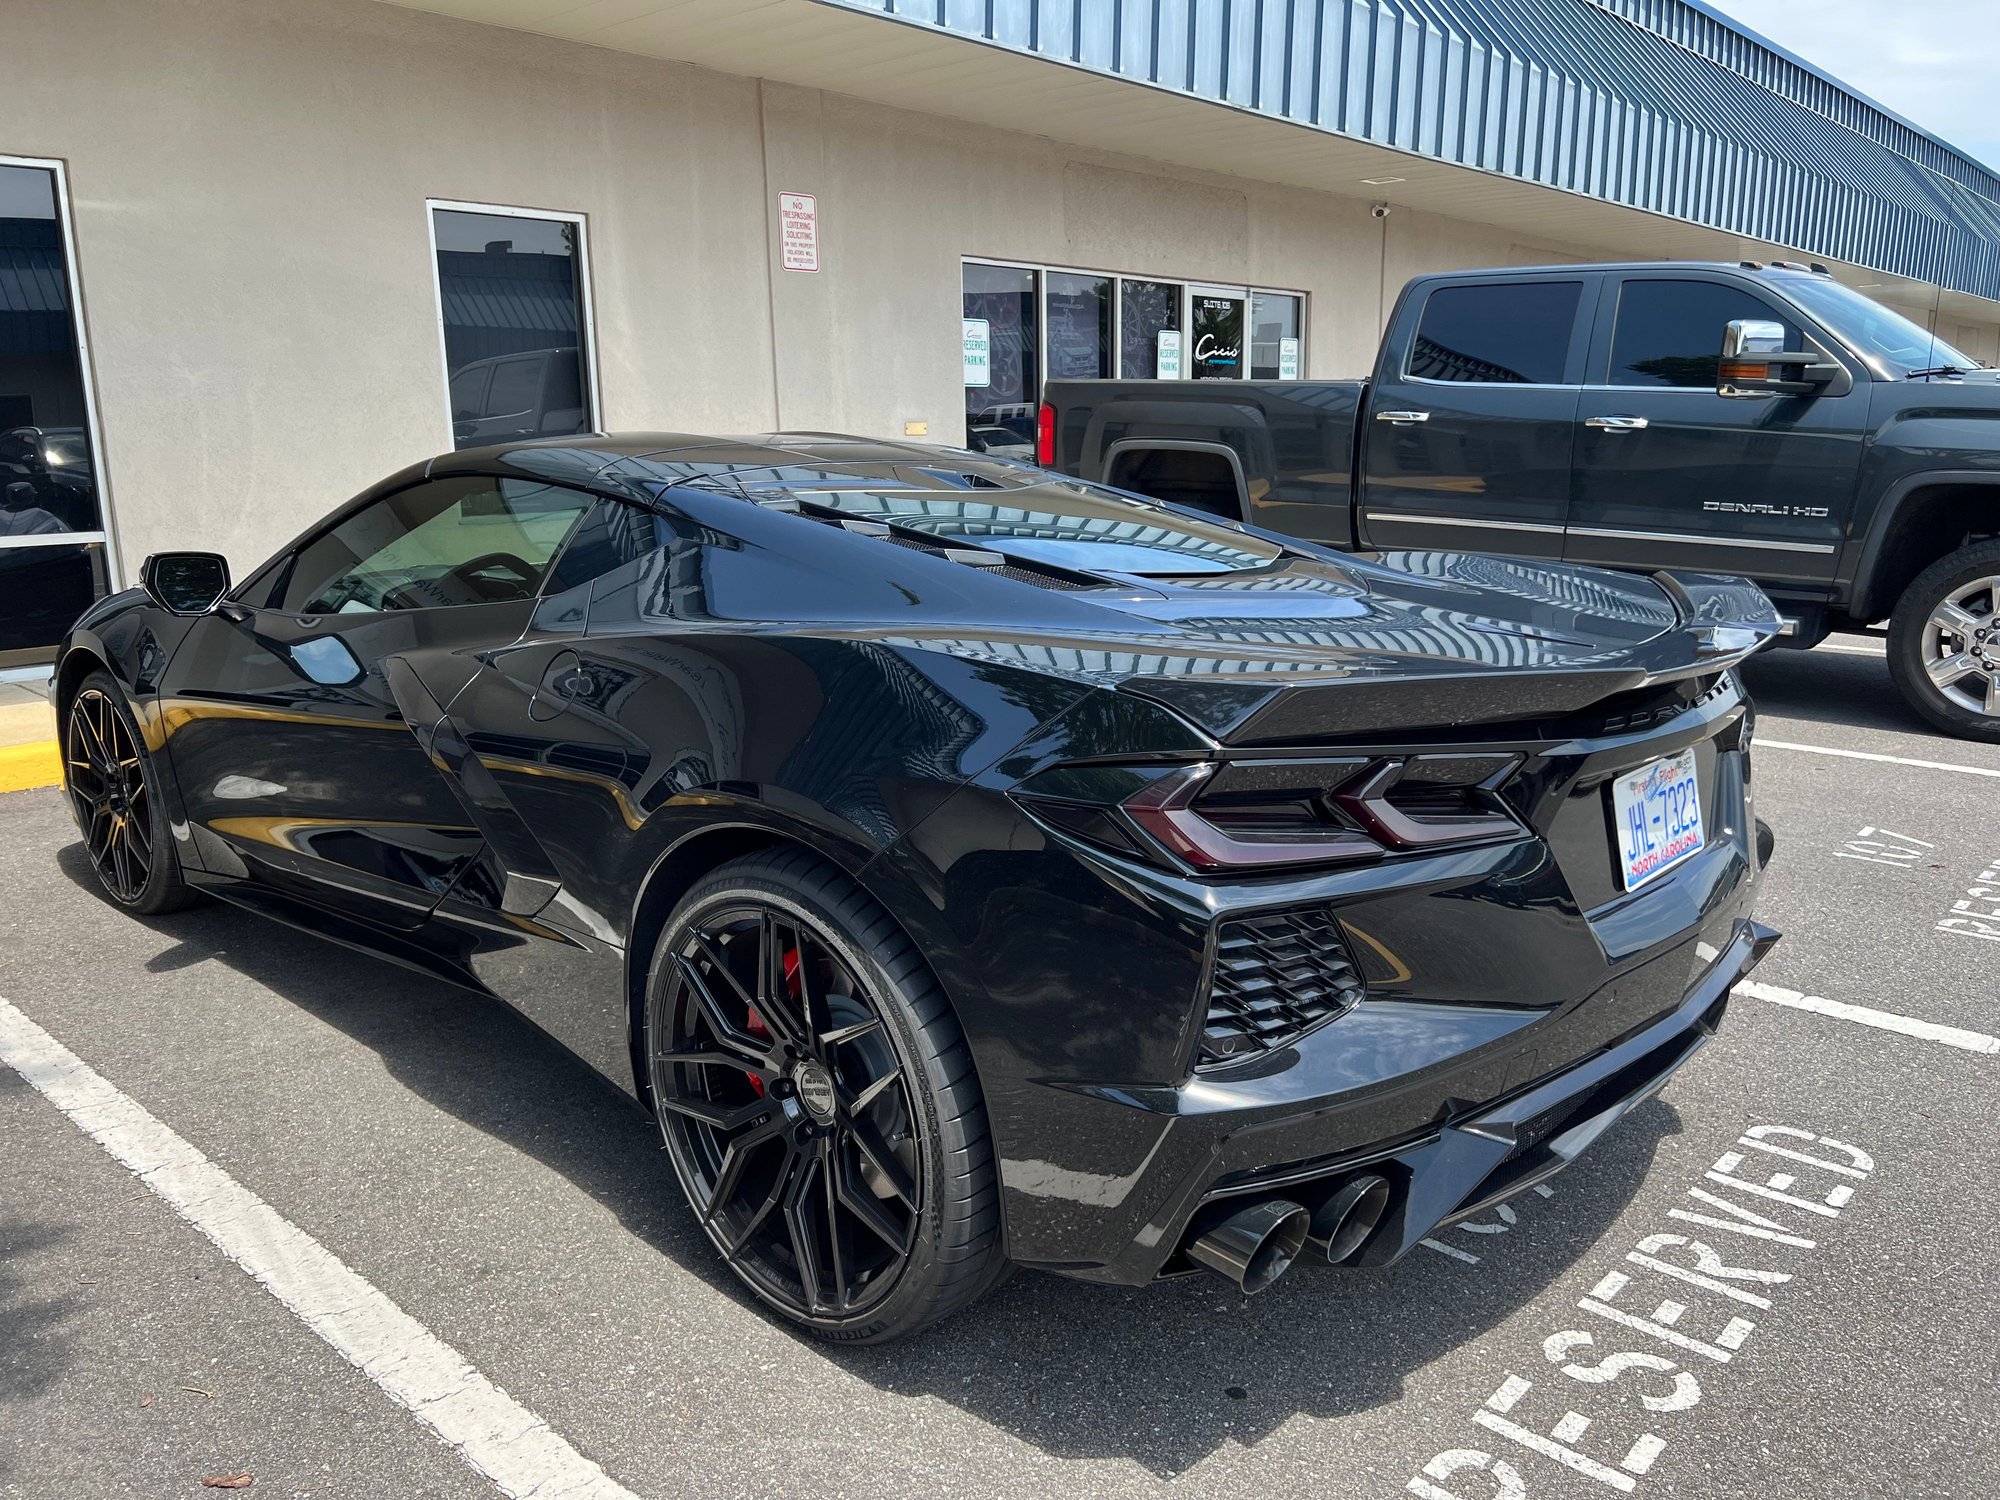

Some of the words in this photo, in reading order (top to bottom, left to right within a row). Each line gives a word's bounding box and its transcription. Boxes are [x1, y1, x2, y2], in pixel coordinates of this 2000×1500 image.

[793, 202, 803, 210] NO
[782, 210, 815, 221] TRESPASSING
[786, 221, 811, 230] LOITERING
[786, 231, 812, 241] SOLICITING
[1203, 300, 1221, 309] SUITE
[1195, 333, 1238, 360] Cicio
[964, 355, 986, 366] PARKING
[1160, 362, 1178, 371] PARKING
[1703, 501, 1789, 515] DENALI
[1792, 506, 1829, 517] HD
[1628, 777, 1699, 861] JHL-7323
[1631, 852, 1659, 880] NORTH
[1660, 832, 1698, 863] CAROLINA
